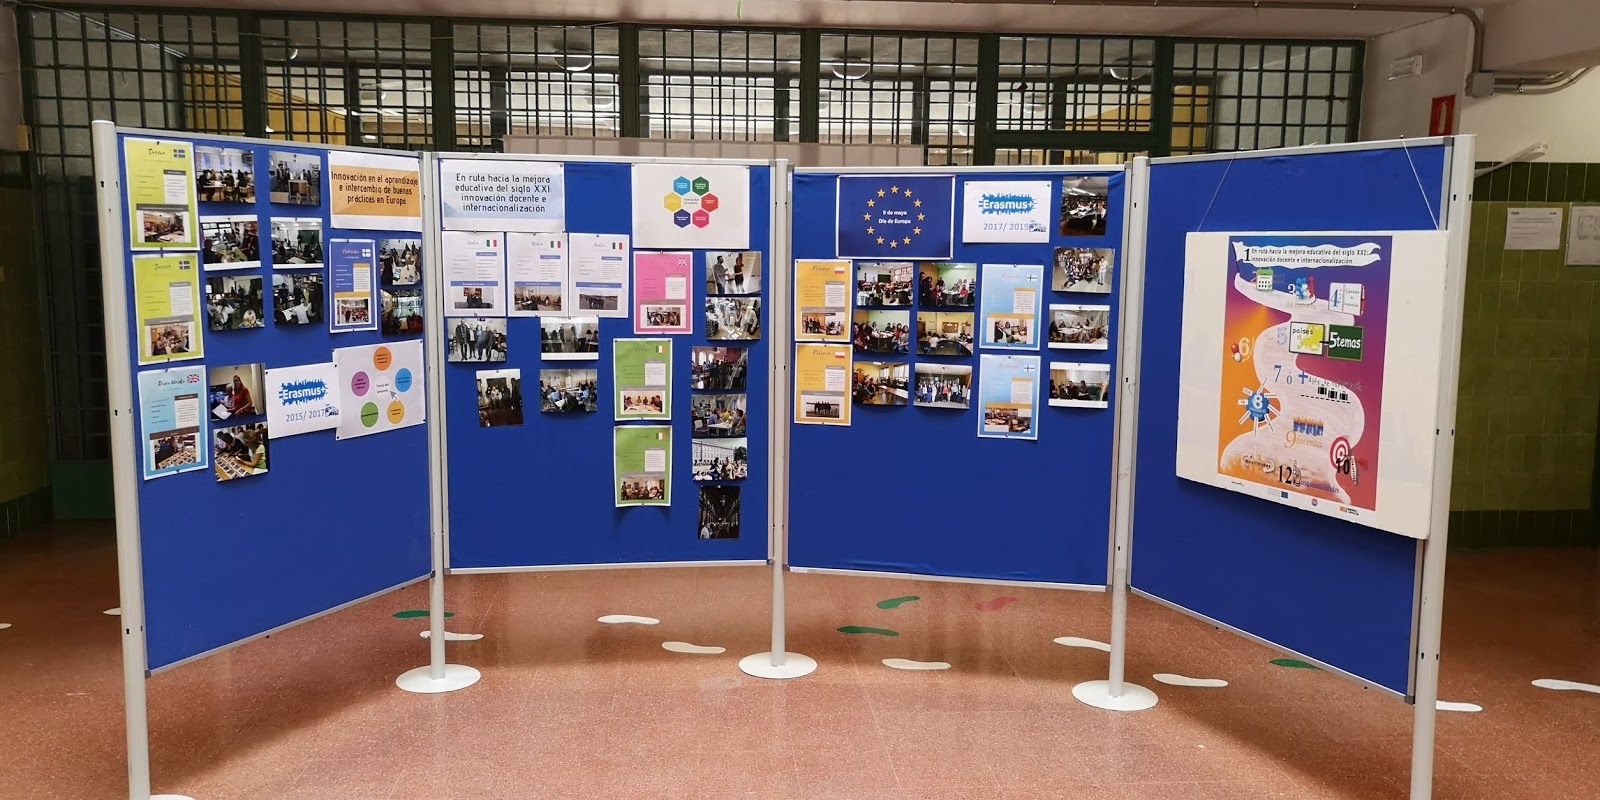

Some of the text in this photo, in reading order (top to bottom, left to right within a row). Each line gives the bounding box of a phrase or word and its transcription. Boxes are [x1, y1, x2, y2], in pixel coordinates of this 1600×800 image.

[332, 171, 366, 182] Innovación
[377, 174, 382, 183] el
[384, 176, 418, 187] aprendizaje
[456, 173, 466, 182] En
[469, 174, 485, 182] ruta
[488, 174, 510, 183] hacia
[522, 175, 551, 184] mejora
[346, 183, 382, 194] intercambio
[384, 186, 391, 194] de
[392, 186, 412, 195] buenas
[455, 184, 494, 192] educativa
[511, 185, 530, 194] siglo
[347, 195, 375, 204] prácticas
[386, 196, 406, 206] Europa
[461, 193, 506, 202] innovación
[509, 194, 540, 202] docente
[463, 203, 546, 212] internacionalización
[983, 200, 1034, 209] Erasmus+
[1244, 248, 1250, 261] 1
[1239, 337, 1250, 356] 6
[1274, 364, 1282, 382] 7
[283, 386, 326, 400] Erasmus+
[309, 409, 325, 418] 2017
[1279, 465, 1292, 484] 12
